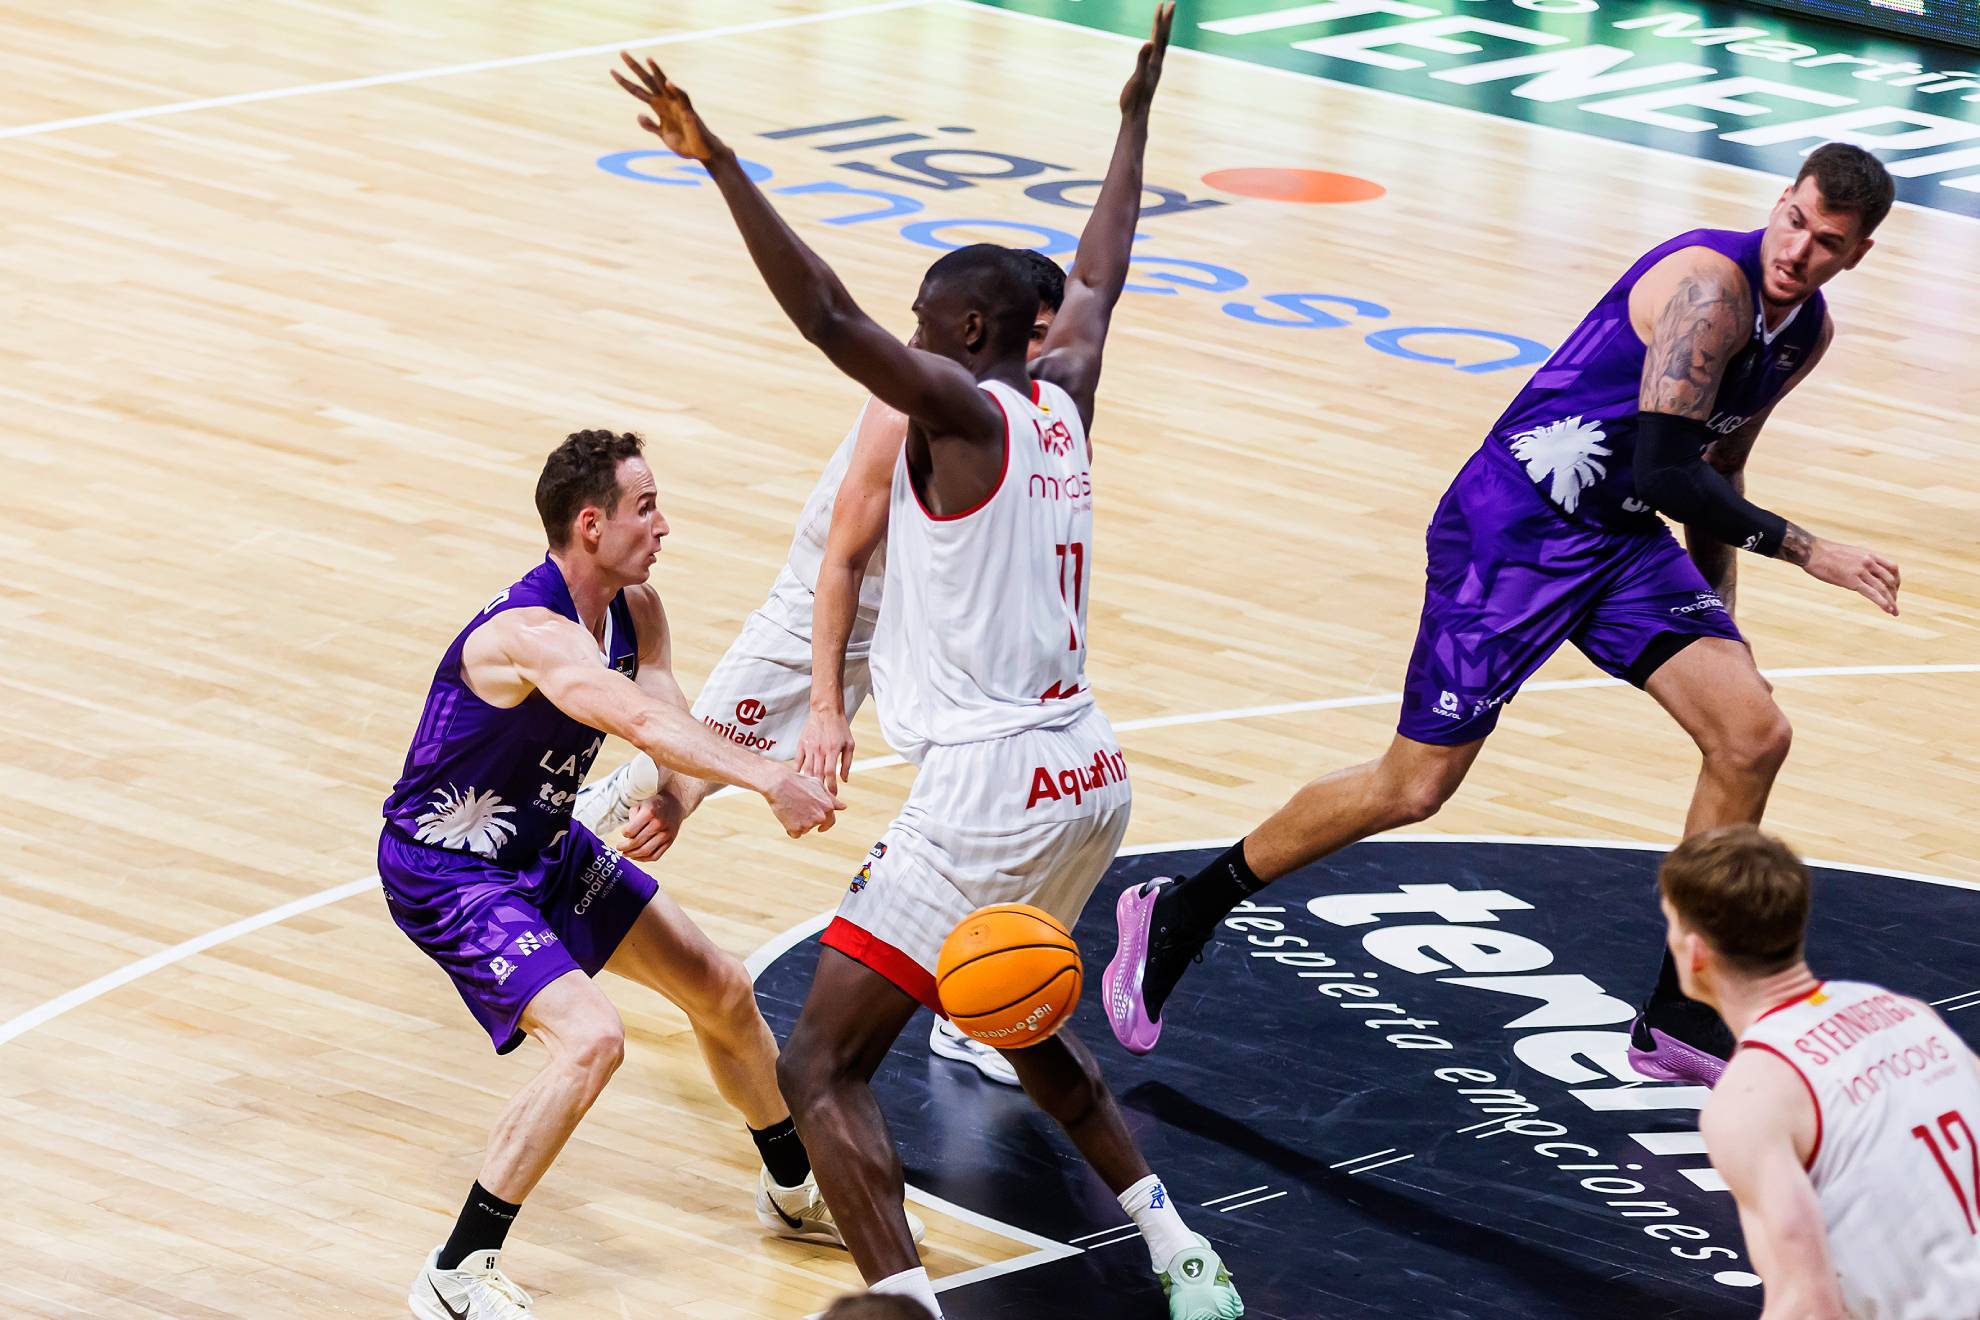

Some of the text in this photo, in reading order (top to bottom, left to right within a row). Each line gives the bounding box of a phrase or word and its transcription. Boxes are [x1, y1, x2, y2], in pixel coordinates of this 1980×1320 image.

[757, 115, 1231, 216] liga
[704, 715, 777, 751] unilabor
[573, 861, 616, 915] Canarias
[580, 854, 607, 885] Islas
